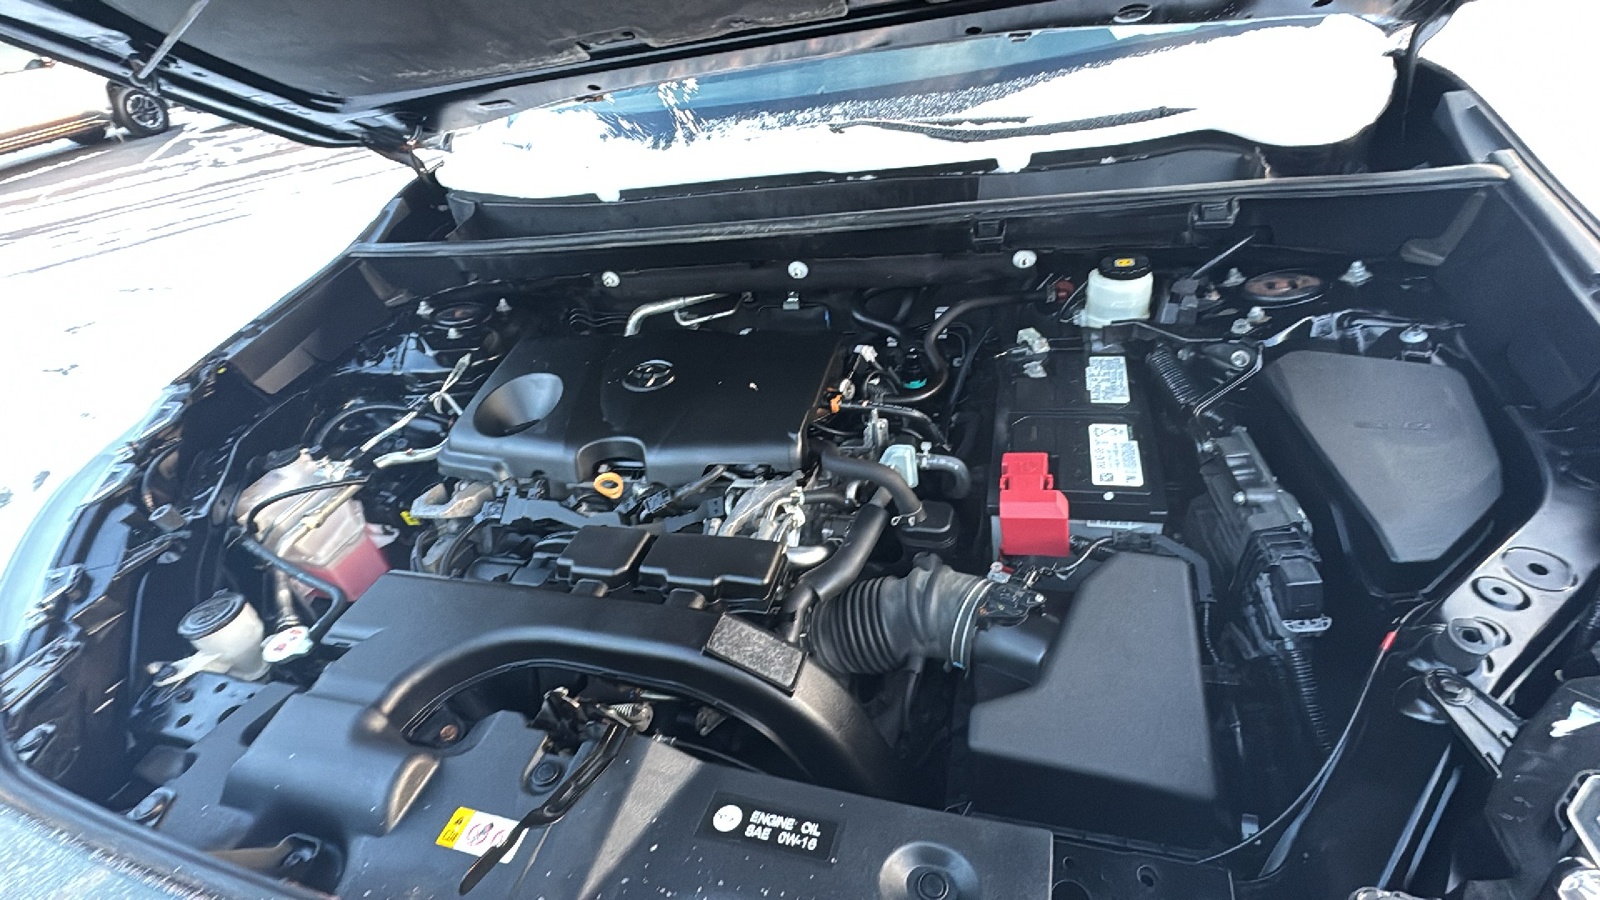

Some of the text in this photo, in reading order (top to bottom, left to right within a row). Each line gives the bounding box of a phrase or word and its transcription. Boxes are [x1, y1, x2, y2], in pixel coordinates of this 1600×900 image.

[744, 824, 772, 840] SAE
[750, 810, 821, 837] ENGINE OIL
